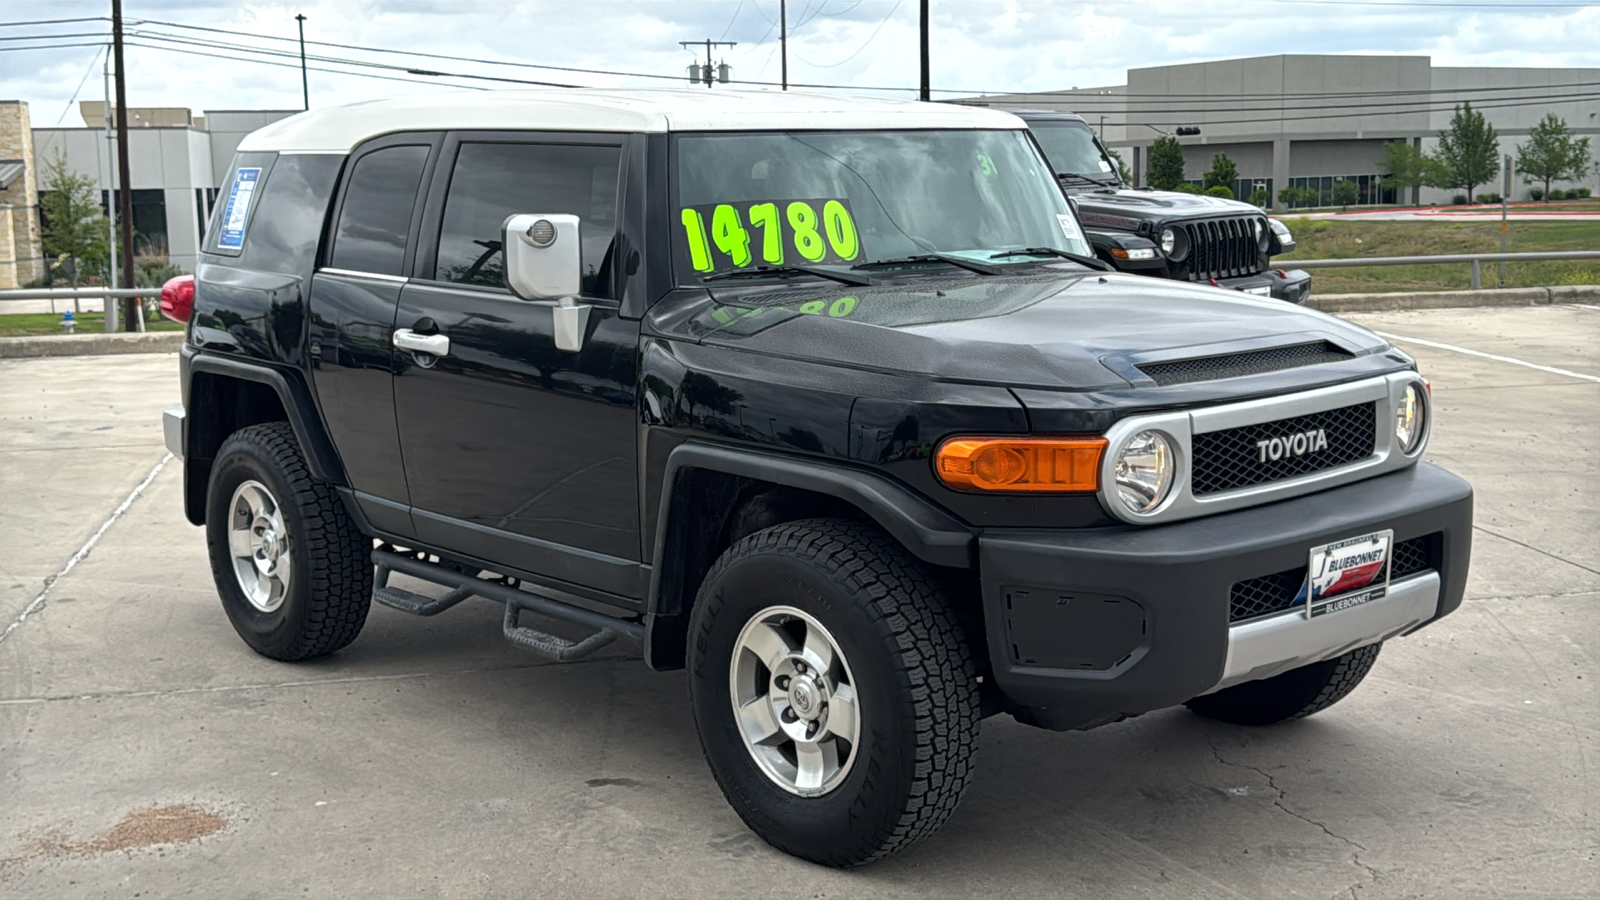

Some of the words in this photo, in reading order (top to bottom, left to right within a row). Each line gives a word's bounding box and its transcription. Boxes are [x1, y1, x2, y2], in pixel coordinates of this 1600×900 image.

[680, 199, 859, 273] 14780
[1256, 428, 1328, 463] TOYOTA
[1328, 549, 1383, 572] BLUEBONNET
[1325, 593, 1371, 613] BLUEBONNET
[694, 586, 726, 679] KELLY
